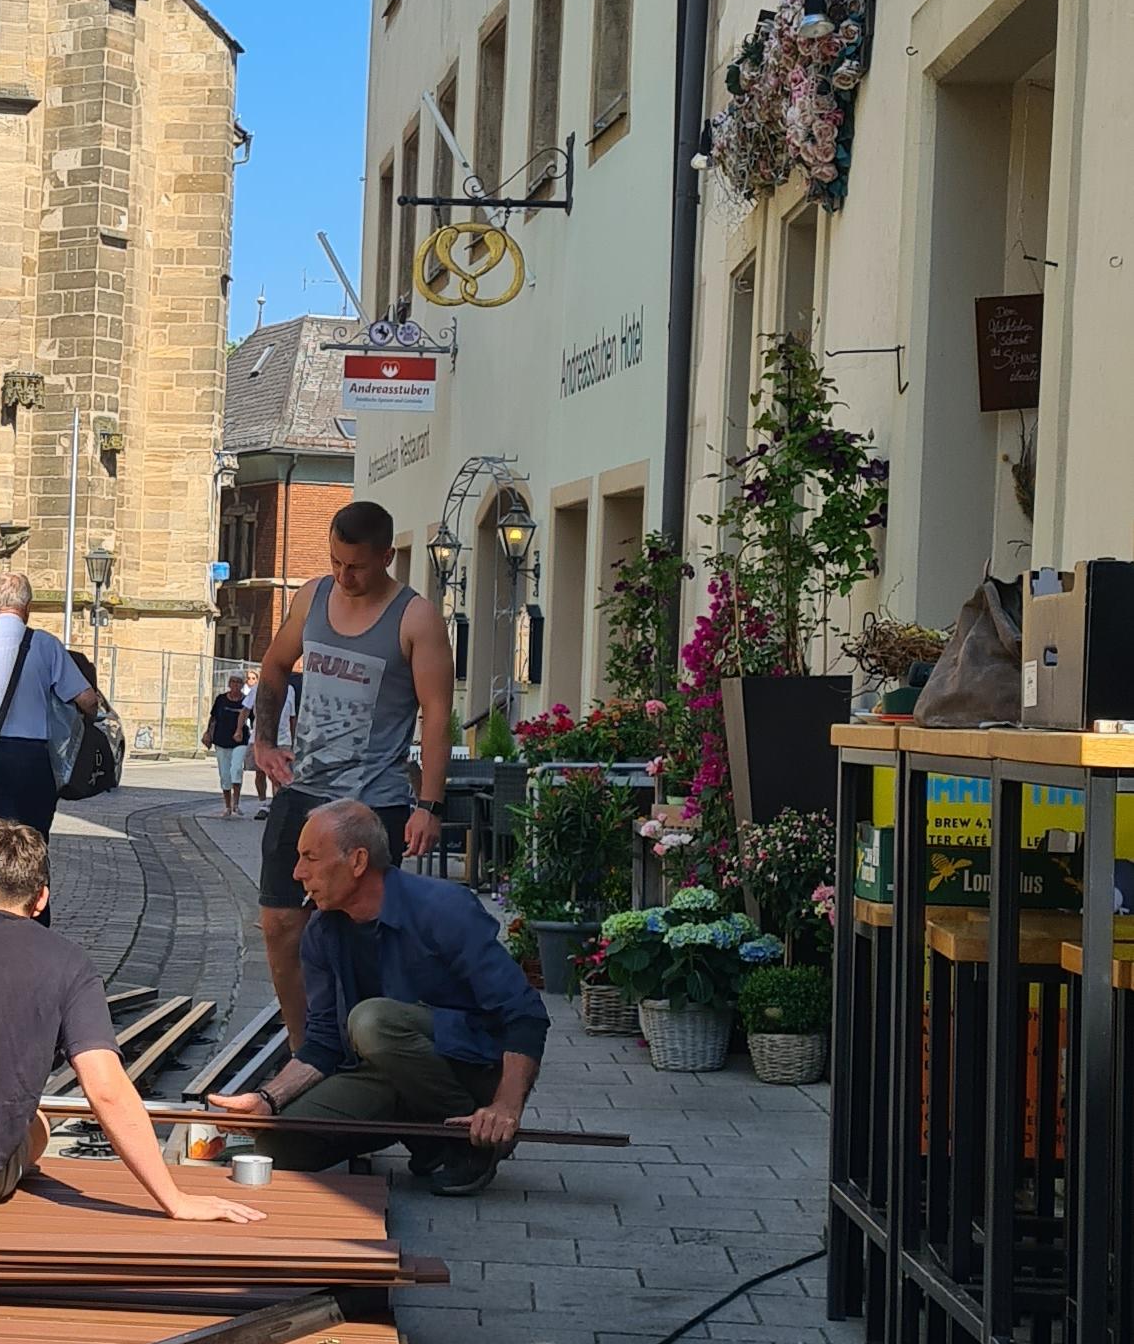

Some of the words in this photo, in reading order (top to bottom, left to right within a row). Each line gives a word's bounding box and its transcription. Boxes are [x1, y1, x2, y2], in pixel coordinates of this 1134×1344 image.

[560, 327, 617, 399] Andreasstuben
[620, 305, 644, 372] Hotel
[349, 382, 430, 396] Andreasstuben
[935, 818, 971, 829] BREW
[957, 833, 987, 846] CAFÉ
